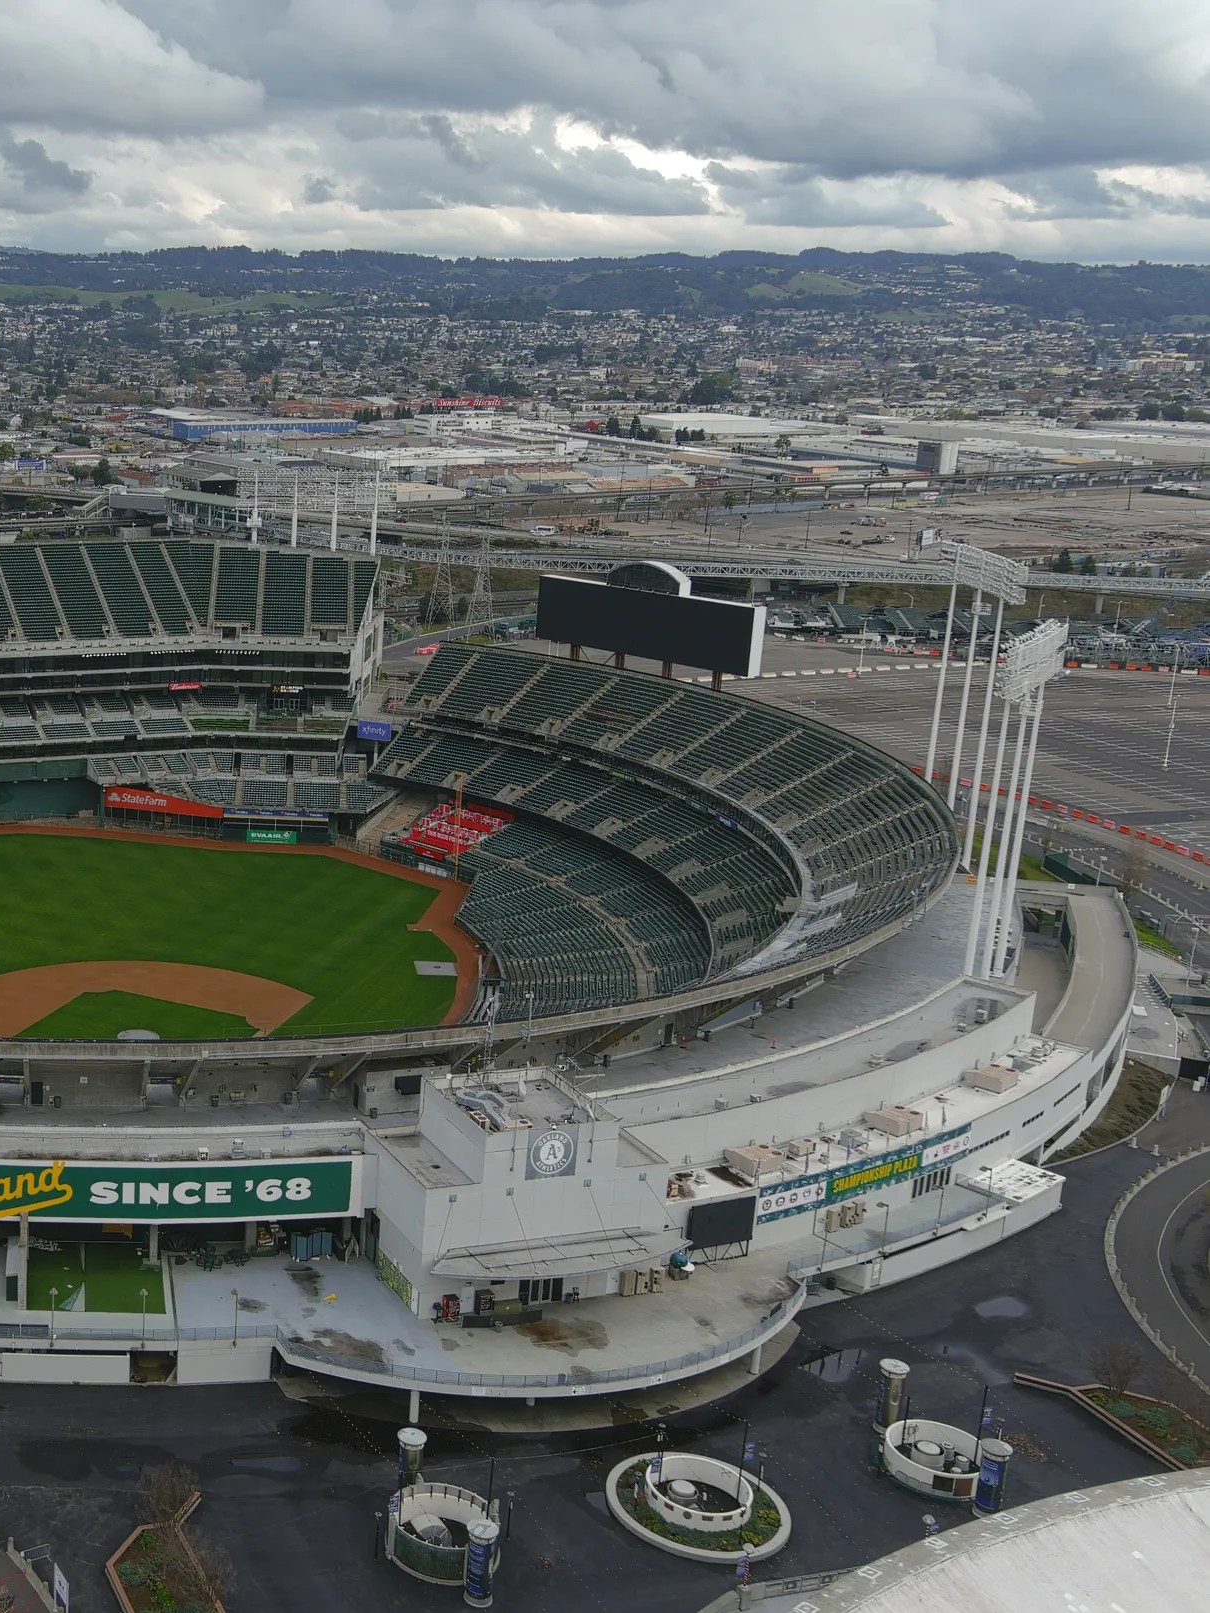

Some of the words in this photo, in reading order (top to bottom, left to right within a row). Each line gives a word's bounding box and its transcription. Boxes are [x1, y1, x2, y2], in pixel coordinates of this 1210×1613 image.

[438, 398, 470, 407] Sunshine
[473, 398, 501, 406] Biscuits
[170, 683, 200, 691] Budweiser
[361, 725, 387, 736] xfinity
[538, 1133, 568, 1147] OAKLAND
[535, 1158, 567, 1172] ATHLETICS
[832, 1164, 893, 1193] CHAMPIONSHIP
[893, 1155, 918, 1174] PLAZA
[90, 1181, 232, 1205] SINCE
[244, 1177, 312, 1203] '68
